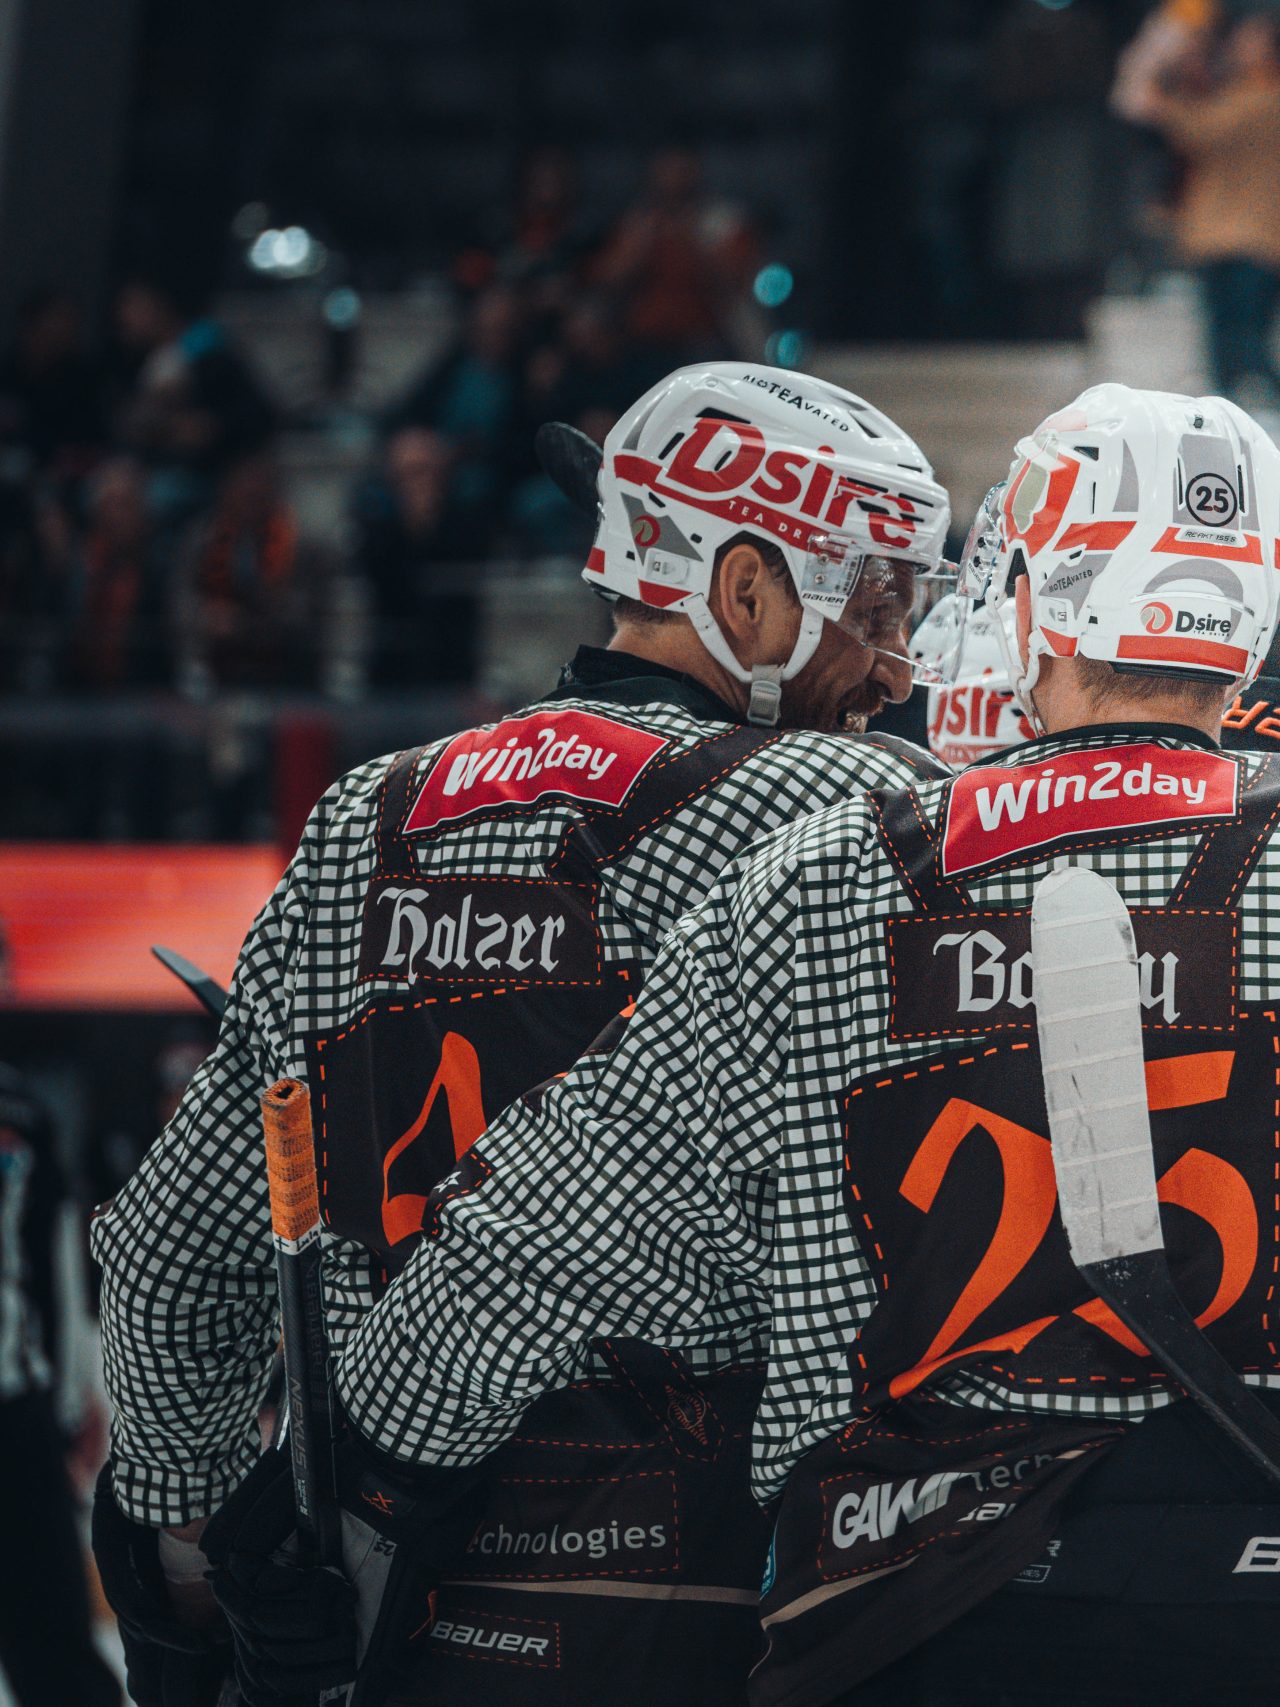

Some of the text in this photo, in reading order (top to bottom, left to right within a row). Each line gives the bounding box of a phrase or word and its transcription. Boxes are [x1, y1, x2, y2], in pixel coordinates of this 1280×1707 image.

[728, 500, 764, 523] TEA
[1195, 486, 1229, 514] 25
[1175, 610, 1232, 633] Dsire
[442, 728, 618, 797] win2day
[975, 760, 1207, 832] win2day
[376, 886, 565, 985] Holzer
[888, 1050, 1259, 1399] 25
[289, 1376, 308, 1471] NEXUS
[429, 1619, 549, 1657] BAUER
